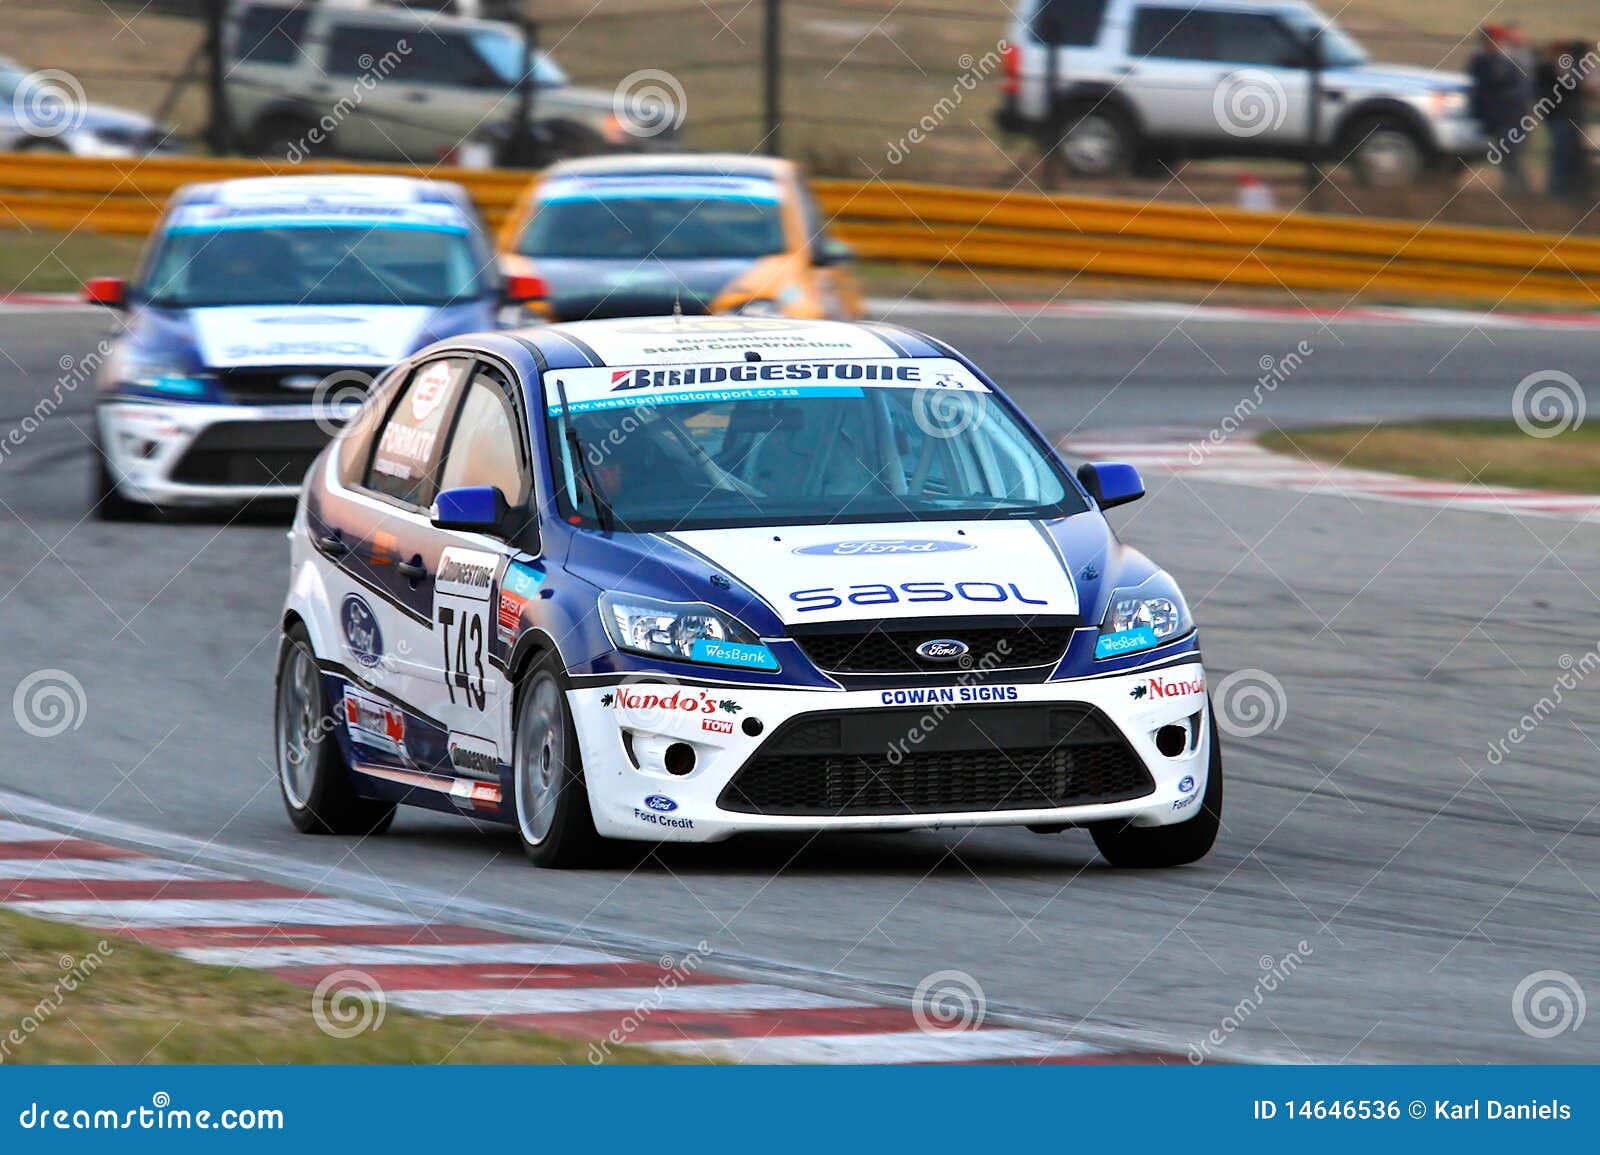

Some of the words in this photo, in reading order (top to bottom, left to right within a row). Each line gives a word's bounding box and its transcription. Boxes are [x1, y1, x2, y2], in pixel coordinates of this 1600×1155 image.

[707, 341, 852, 351] Construction
[611, 363, 921, 393] BRIDGESTONE
[832, 539, 938, 556] Ford
[1100, 633, 1146, 650] WesBank
[438, 606, 486, 712] T43
[705, 645, 765, 663] WesBank
[613, 688, 717, 714] Nando's
[881, 689, 954, 705] COWAN
[959, 687, 1018, 701] SIGNS
[703, 719, 733, 733] TOW
[634, 809, 657, 825] Ford
[659, 815, 694, 829] Credit
